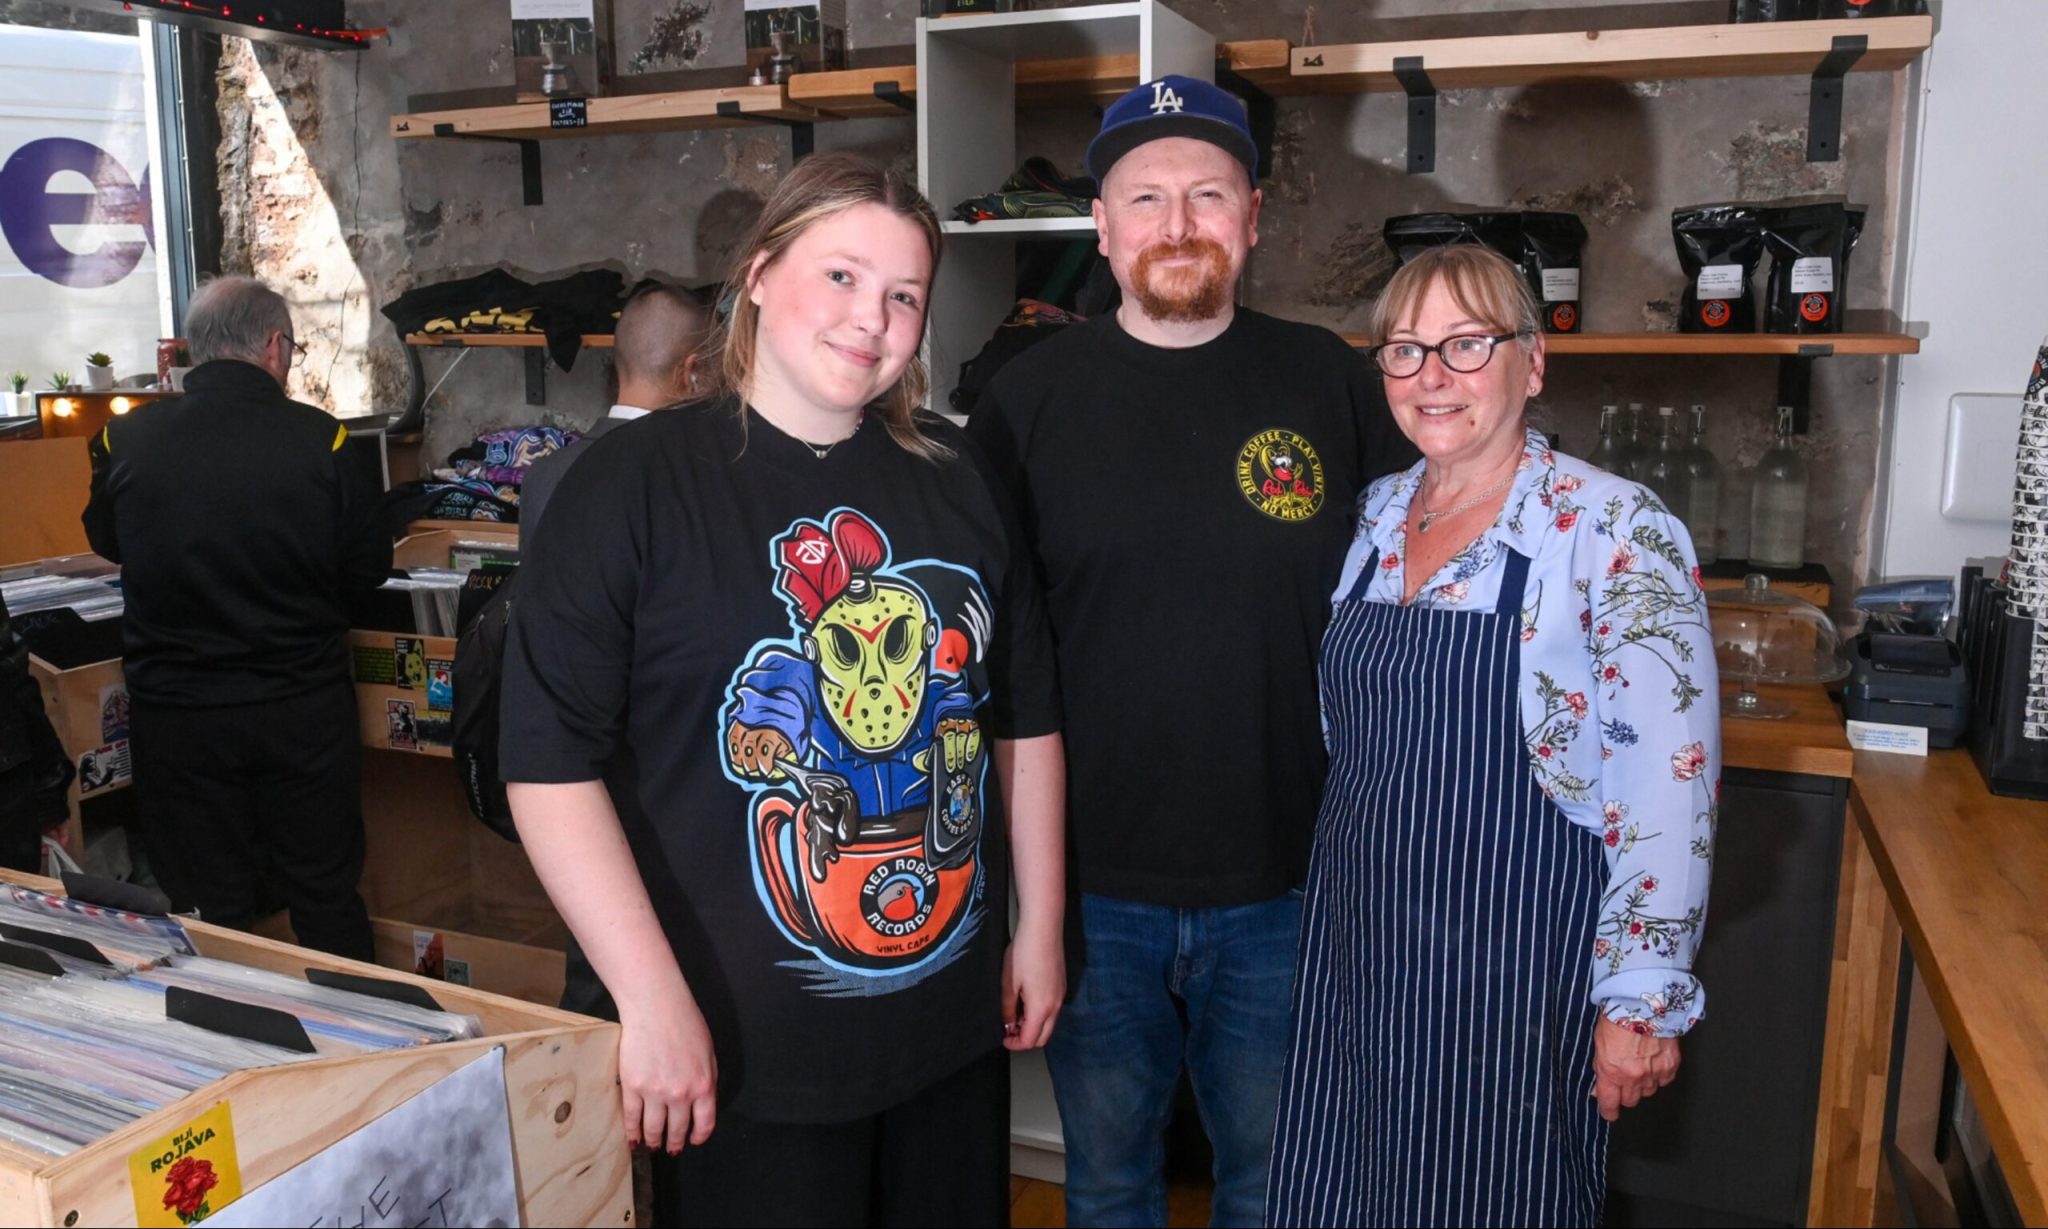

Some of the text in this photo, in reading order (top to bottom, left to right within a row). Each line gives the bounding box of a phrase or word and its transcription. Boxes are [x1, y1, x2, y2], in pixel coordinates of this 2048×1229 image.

[1150, 82, 1183, 115] LA
[0, 137, 156, 289] e
[1239, 431, 1280, 495] DRINK COFFEE
[1291, 435, 1316, 459] PLAY
[1260, 500, 1314, 519] NO MERCY
[863, 858, 936, 895] RED ROBIN
[866, 904, 932, 935] RECORDS
[876, 943, 905, 953] VINYL
[150, 1128, 216, 1173] ROJAVA
